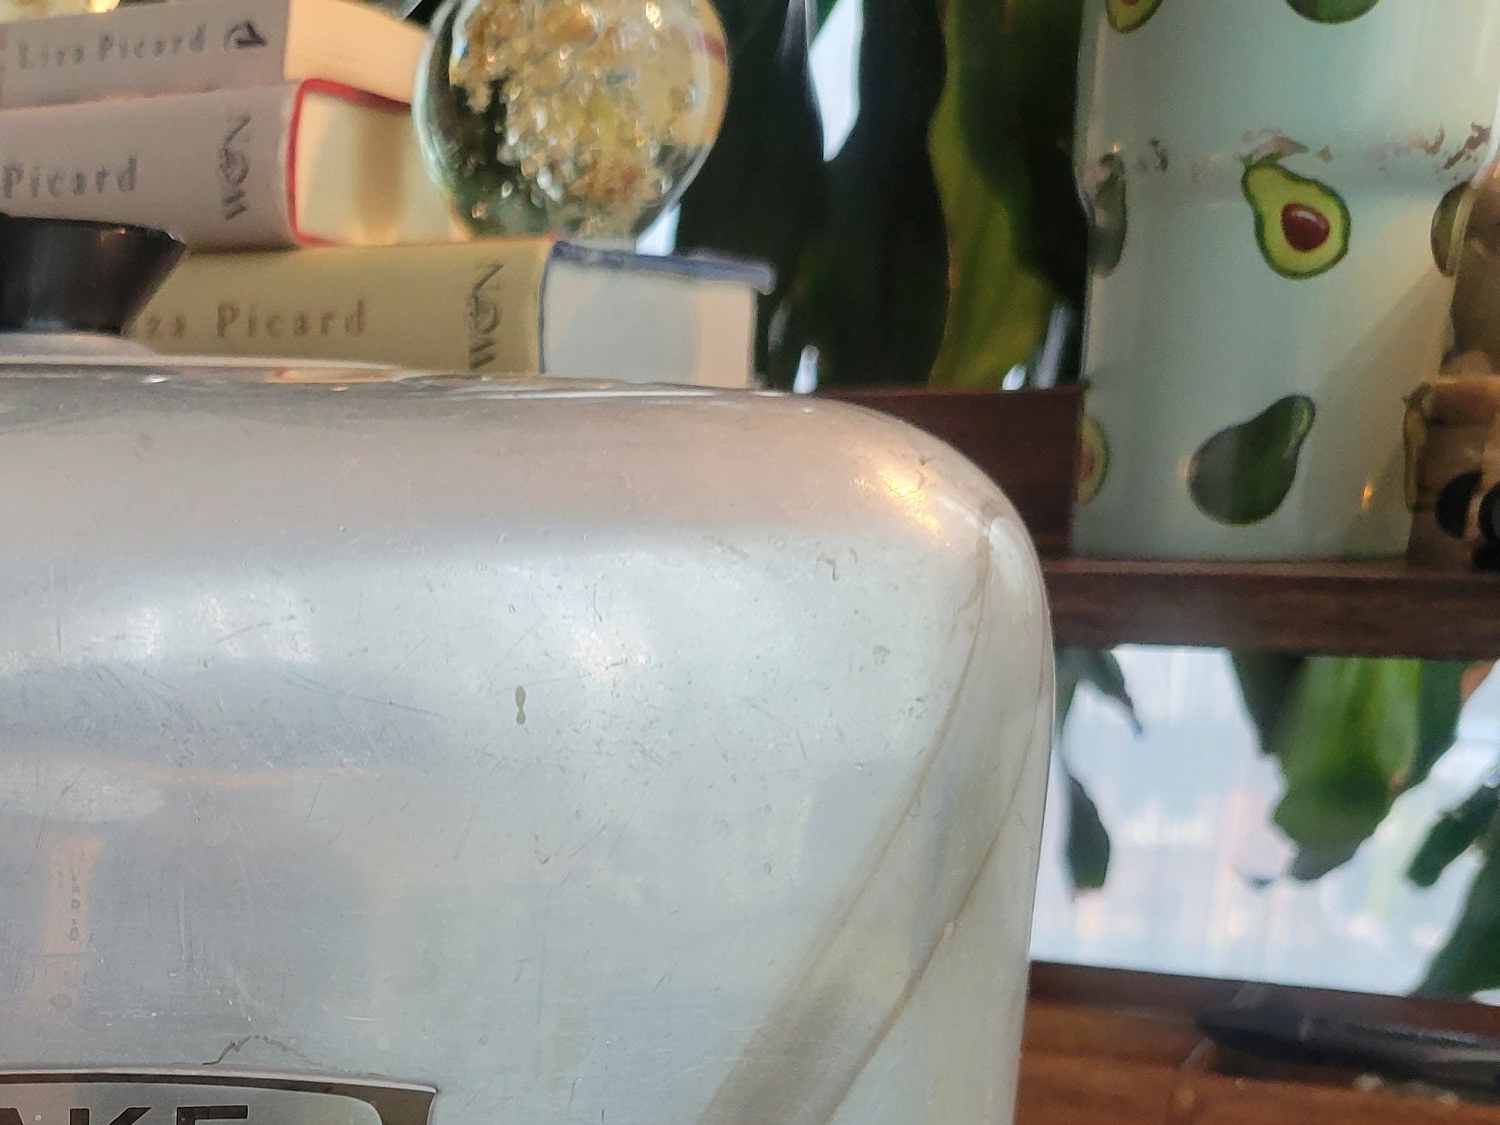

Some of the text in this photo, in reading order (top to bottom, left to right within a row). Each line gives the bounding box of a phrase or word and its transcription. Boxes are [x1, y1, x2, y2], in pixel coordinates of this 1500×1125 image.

[99, 24, 206, 62] Picard
[3, 156, 138, 200] Picard
[216, 299, 368, 338] Picard
